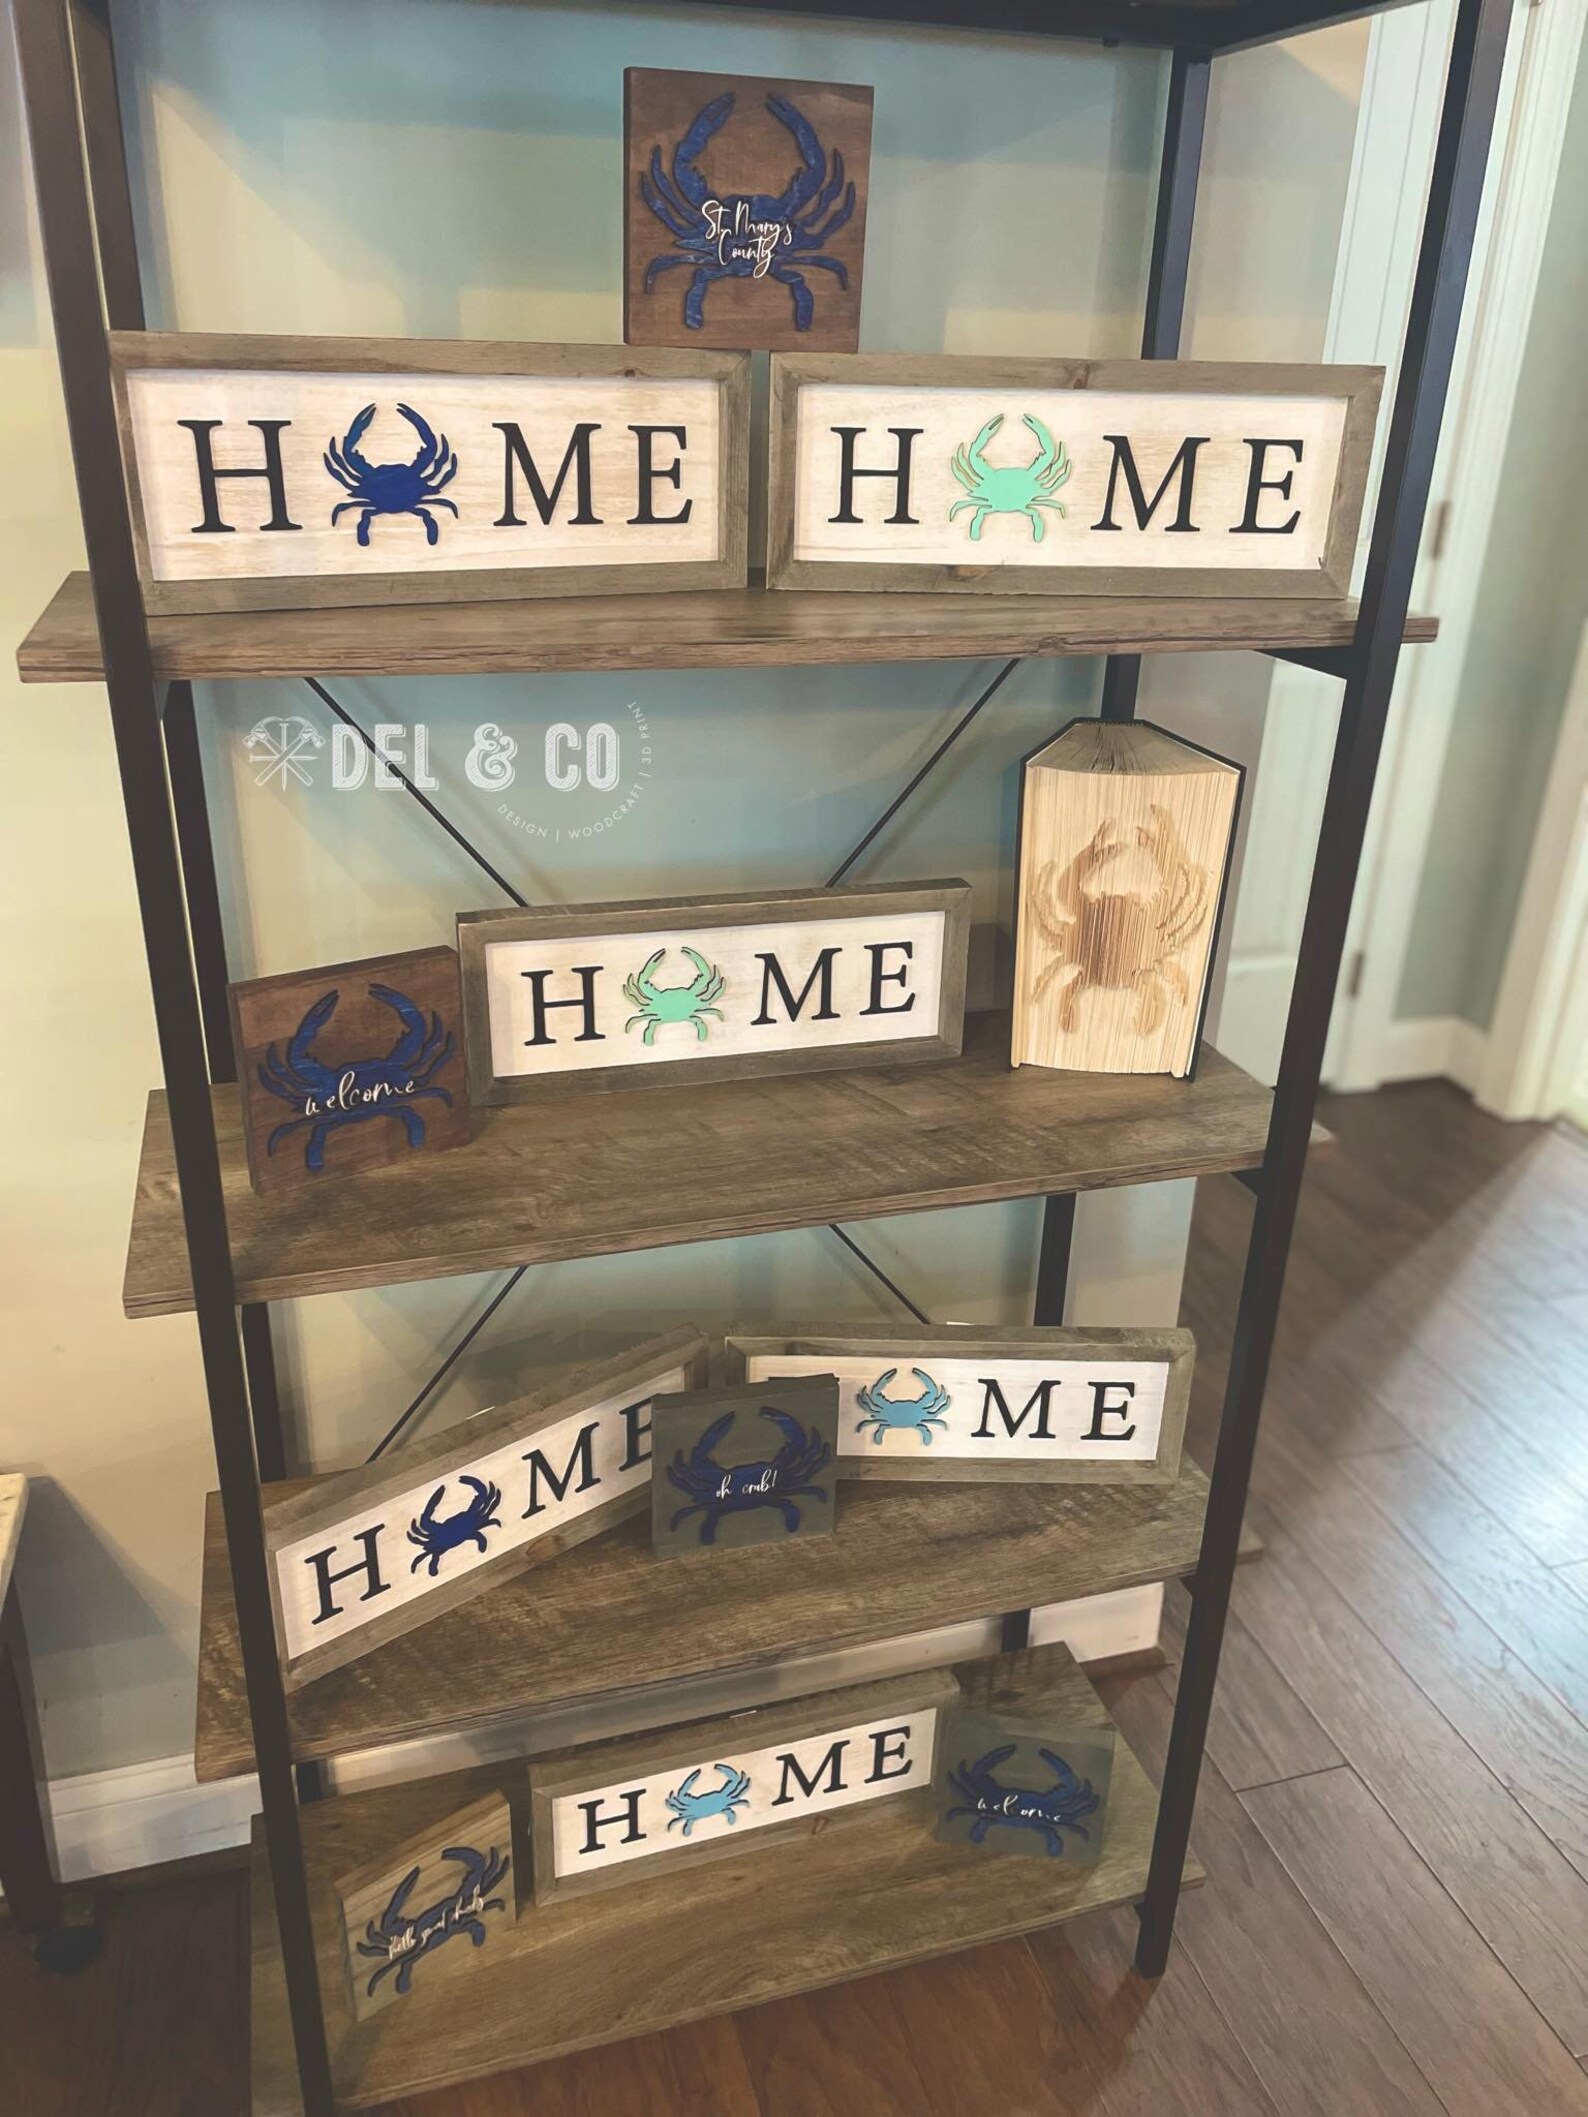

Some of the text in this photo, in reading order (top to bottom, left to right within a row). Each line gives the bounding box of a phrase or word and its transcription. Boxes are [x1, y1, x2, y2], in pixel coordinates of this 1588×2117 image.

[719, 229, 775, 278] County
[305, 1070, 415, 1116] welcome
[716, 1474, 733, 1499] oh
[977, 1795, 1061, 1822] welome
